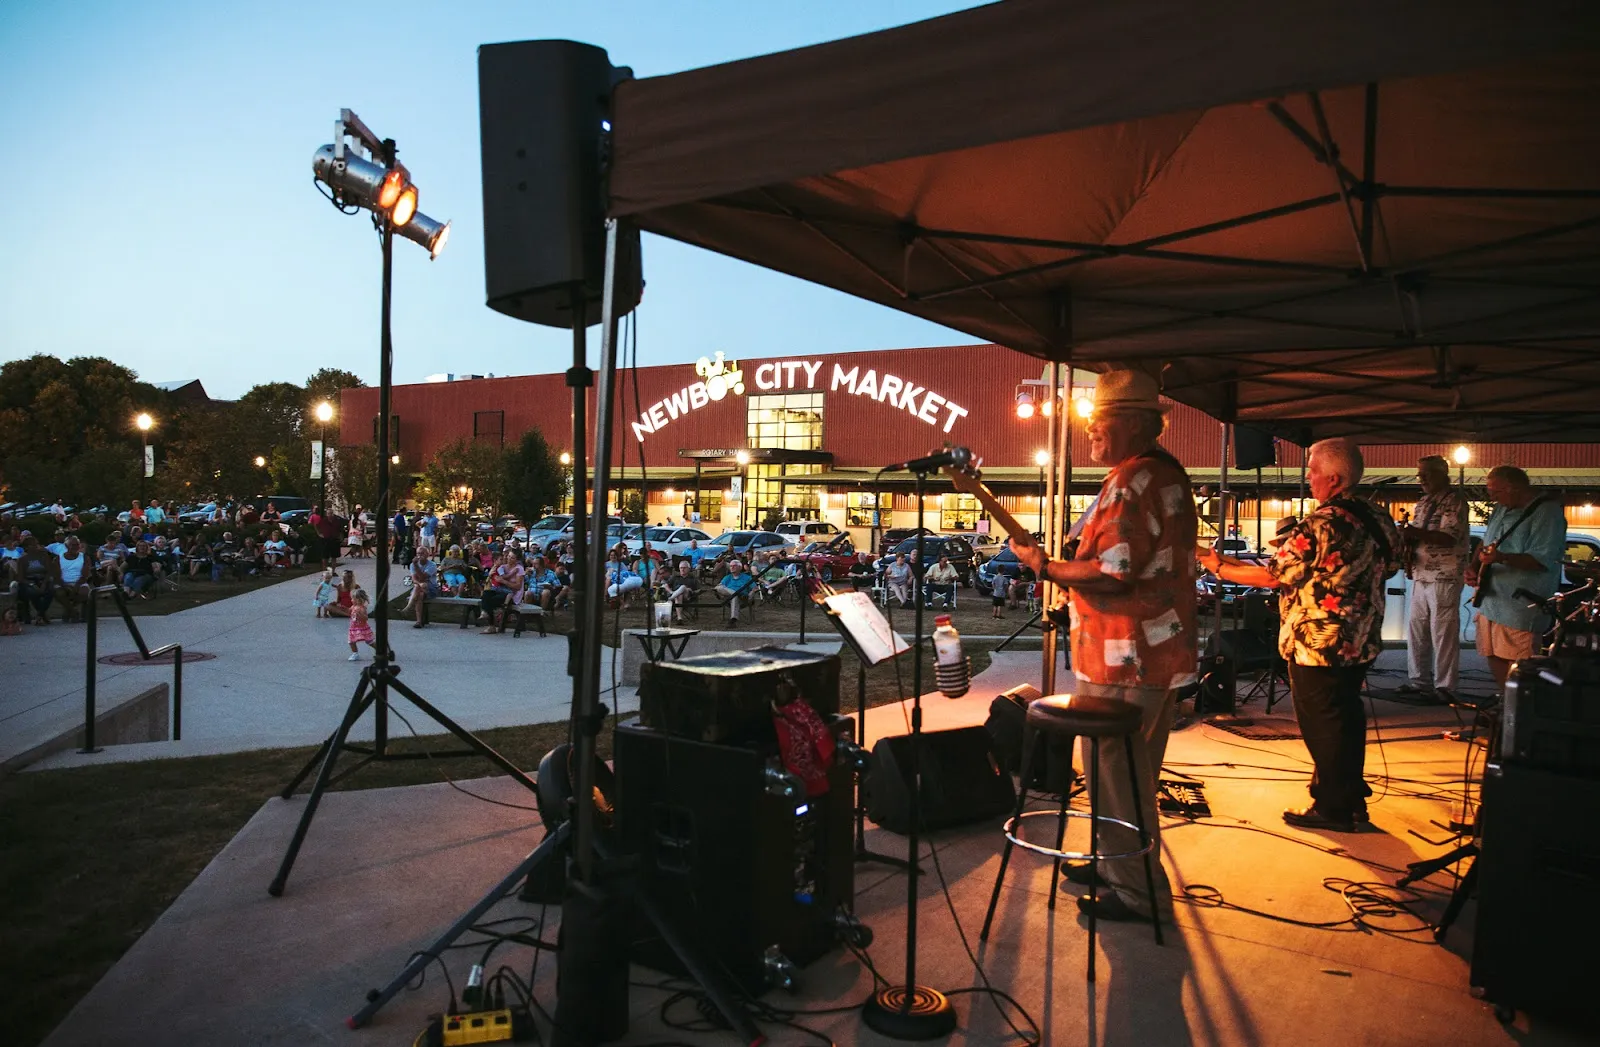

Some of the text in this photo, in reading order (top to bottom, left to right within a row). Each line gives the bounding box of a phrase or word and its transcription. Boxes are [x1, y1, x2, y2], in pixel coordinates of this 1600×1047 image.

[755, 361, 823, 390] CITY
[831, 363, 969, 434] MARKET
[701, 449, 726, 457] ROTARY
